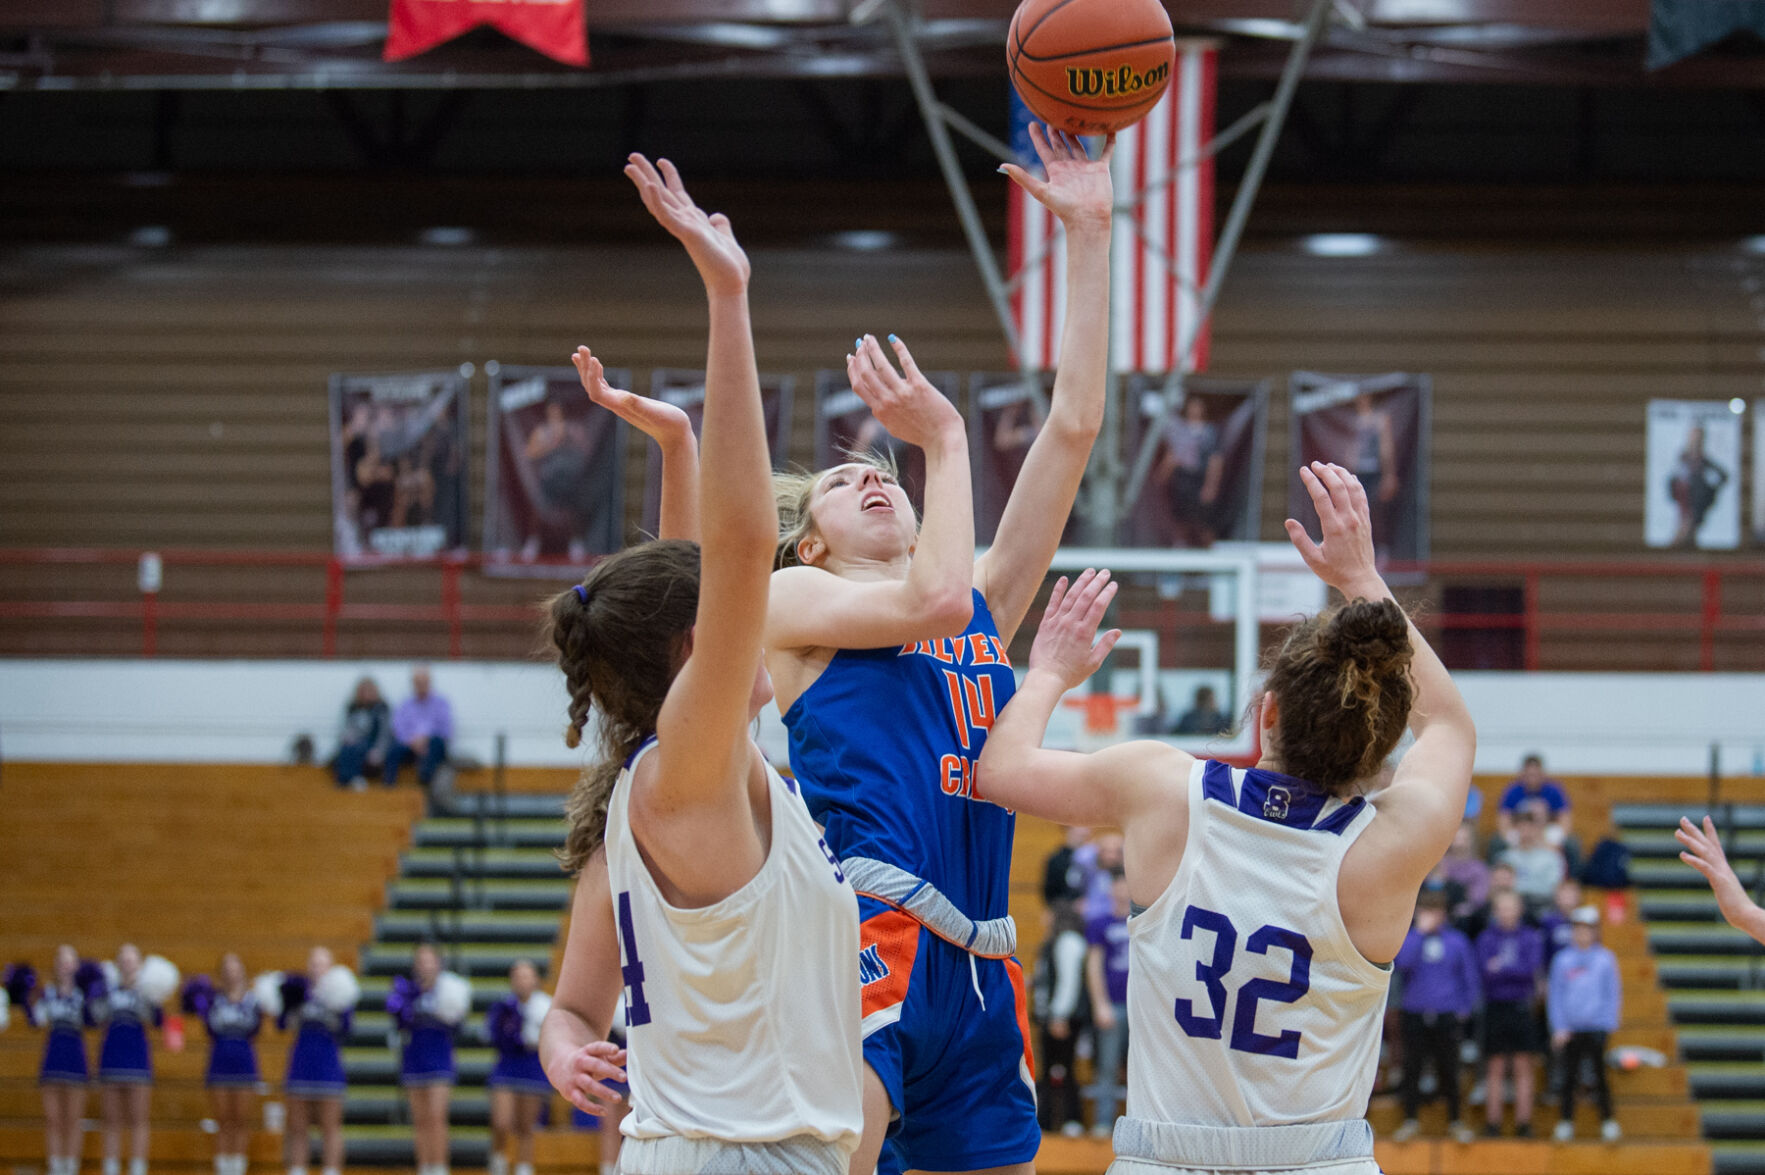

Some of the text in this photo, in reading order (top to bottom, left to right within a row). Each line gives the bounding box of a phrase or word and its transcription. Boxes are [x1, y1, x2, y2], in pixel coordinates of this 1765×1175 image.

[1065, 61, 1170, 98] Wilson
[942, 668, 996, 750] 14
[1175, 904, 1314, 1060] 32
